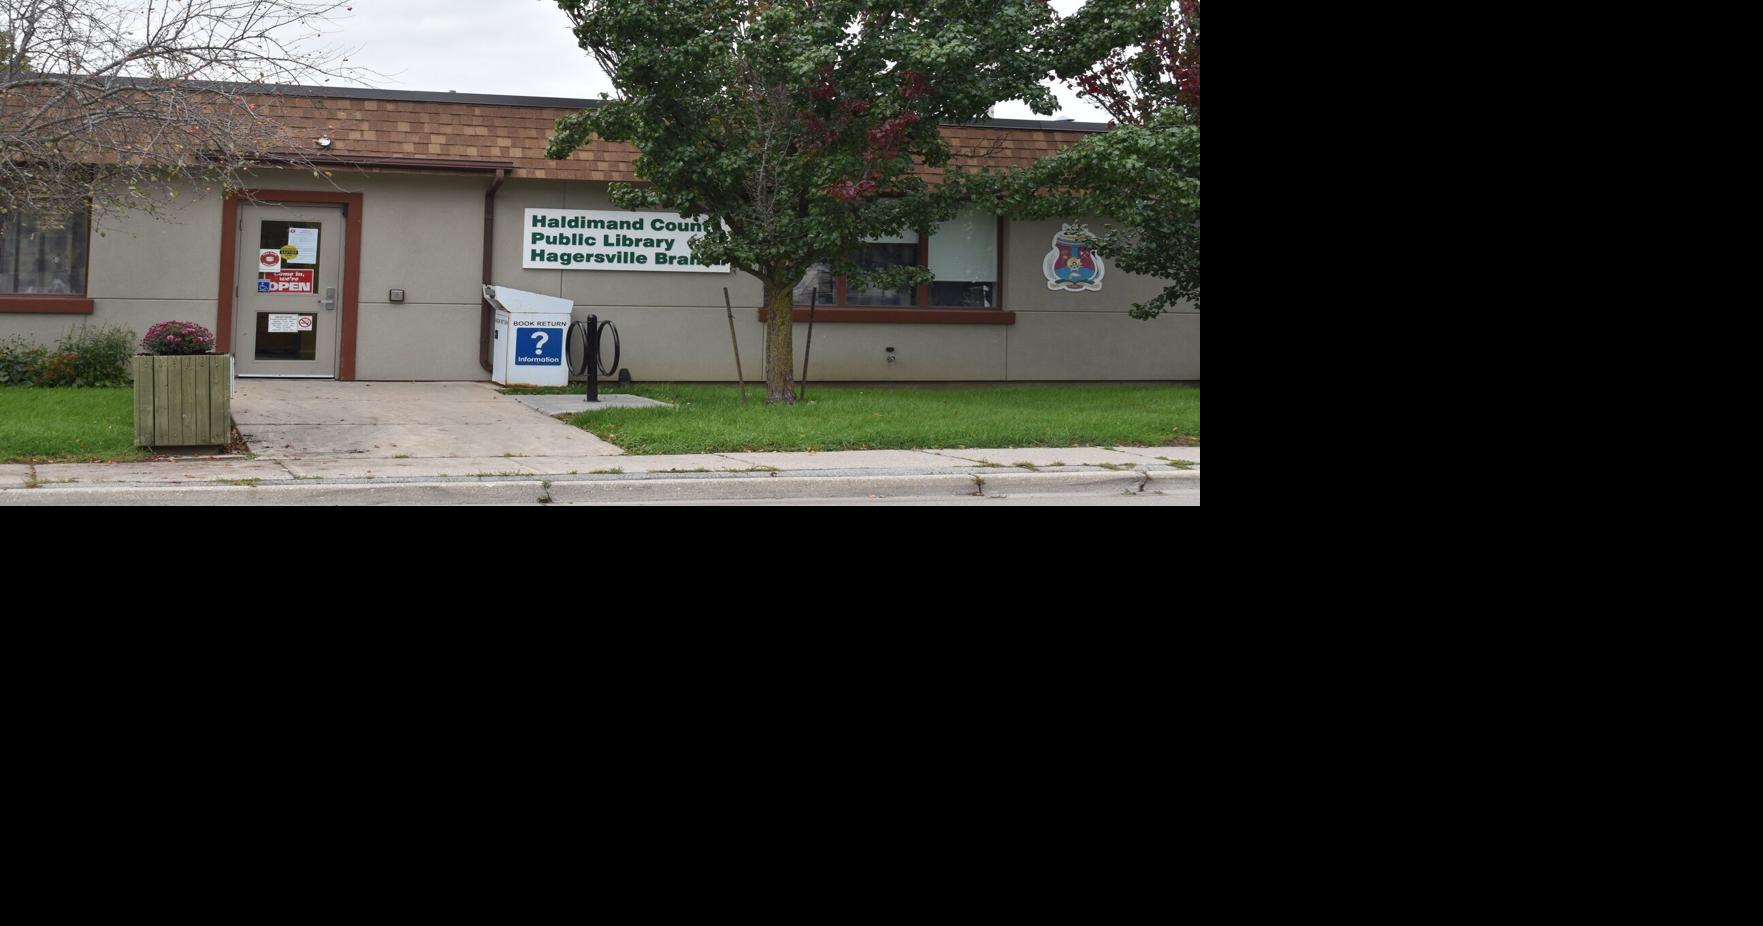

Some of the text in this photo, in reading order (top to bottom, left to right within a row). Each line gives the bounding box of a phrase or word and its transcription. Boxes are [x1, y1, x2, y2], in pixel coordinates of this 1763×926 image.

[532, 214, 711, 232] Haldimand Coun
[531, 232, 675, 251] Public Library
[530, 248, 730, 266] Hagersville Bran
[269, 281, 311, 291] OPEN
